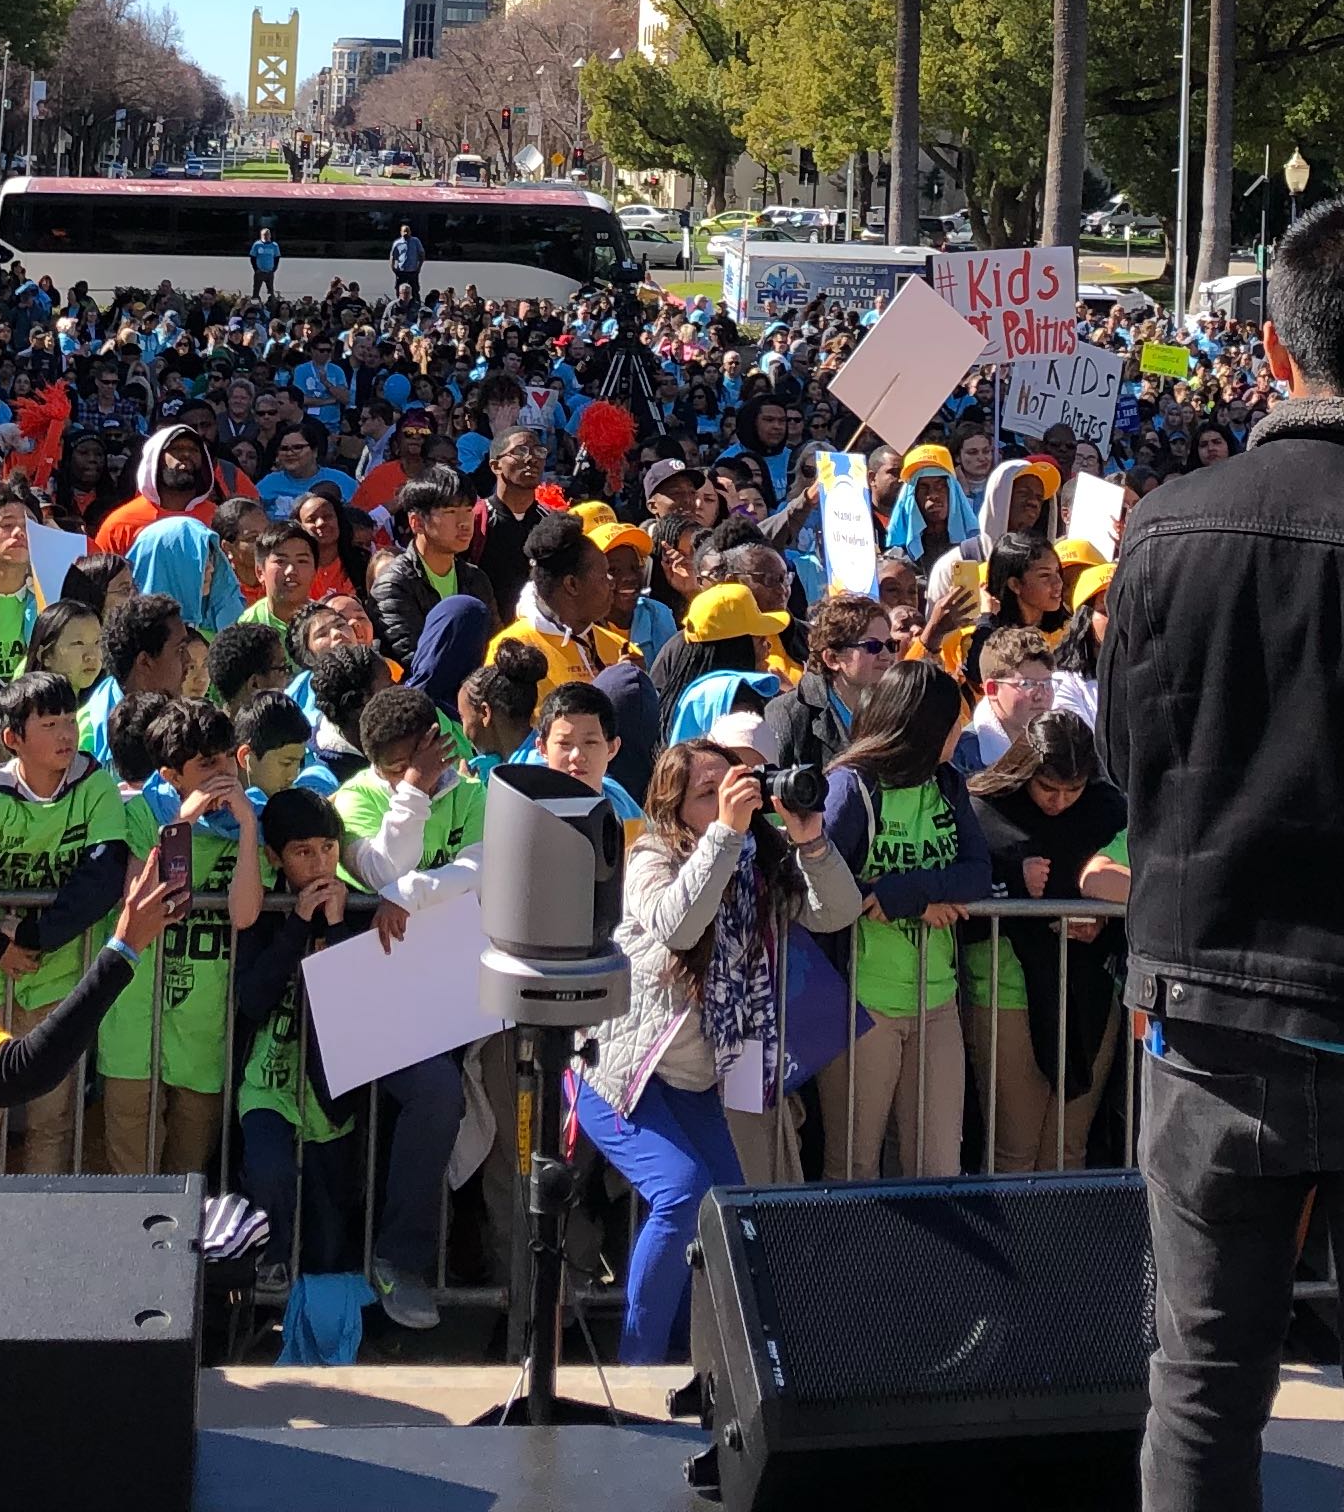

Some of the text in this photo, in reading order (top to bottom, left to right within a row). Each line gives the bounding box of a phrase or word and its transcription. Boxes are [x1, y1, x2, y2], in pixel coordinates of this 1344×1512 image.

[833, 275, 876, 286] EMT's
[757, 289, 809, 305] EMS
[851, 287, 890, 299] YOUR
[1002, 309, 1077, 360] Politics
[872, 839, 916, 865] WE
[164, 922, 231, 961] OO!
